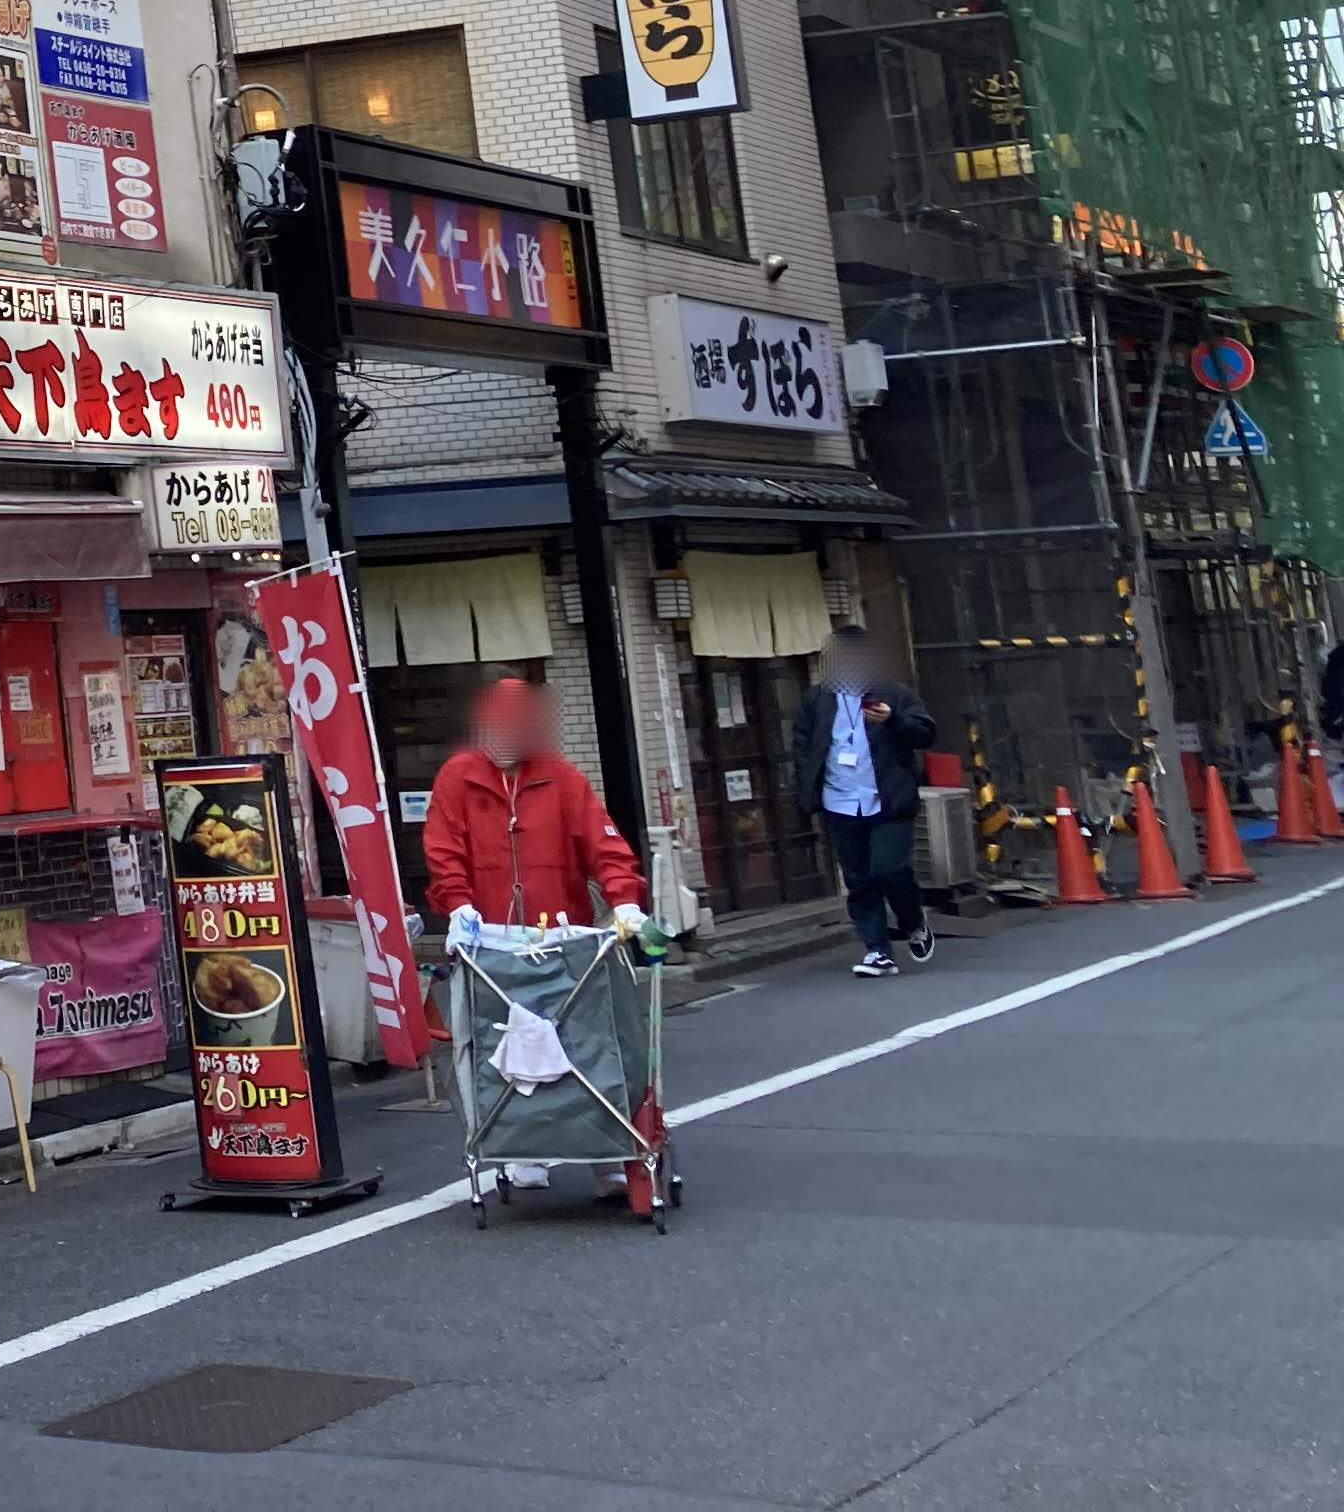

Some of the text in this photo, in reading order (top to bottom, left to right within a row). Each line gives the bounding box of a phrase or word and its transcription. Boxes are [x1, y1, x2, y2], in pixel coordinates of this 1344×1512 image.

[57, 55, 72, 71] TEL
[58, 70, 74, 86] FAX
[358, 204, 548, 308] 美久仁小路
[68, 289, 125, 331] 専門店
[191, 320, 265, 367] からあげ弁当
[727, 315, 824, 420] ずぼら
[206, 382, 262, 431] 480円
[166, 469, 251, 507] からあげ
[172, 511, 210, 545] Tel
[183, 908, 281, 942] 480円
[49, 988, 156, 1035] Torimasu
[221, 1125, 309, 1159] 天下鳥ます
